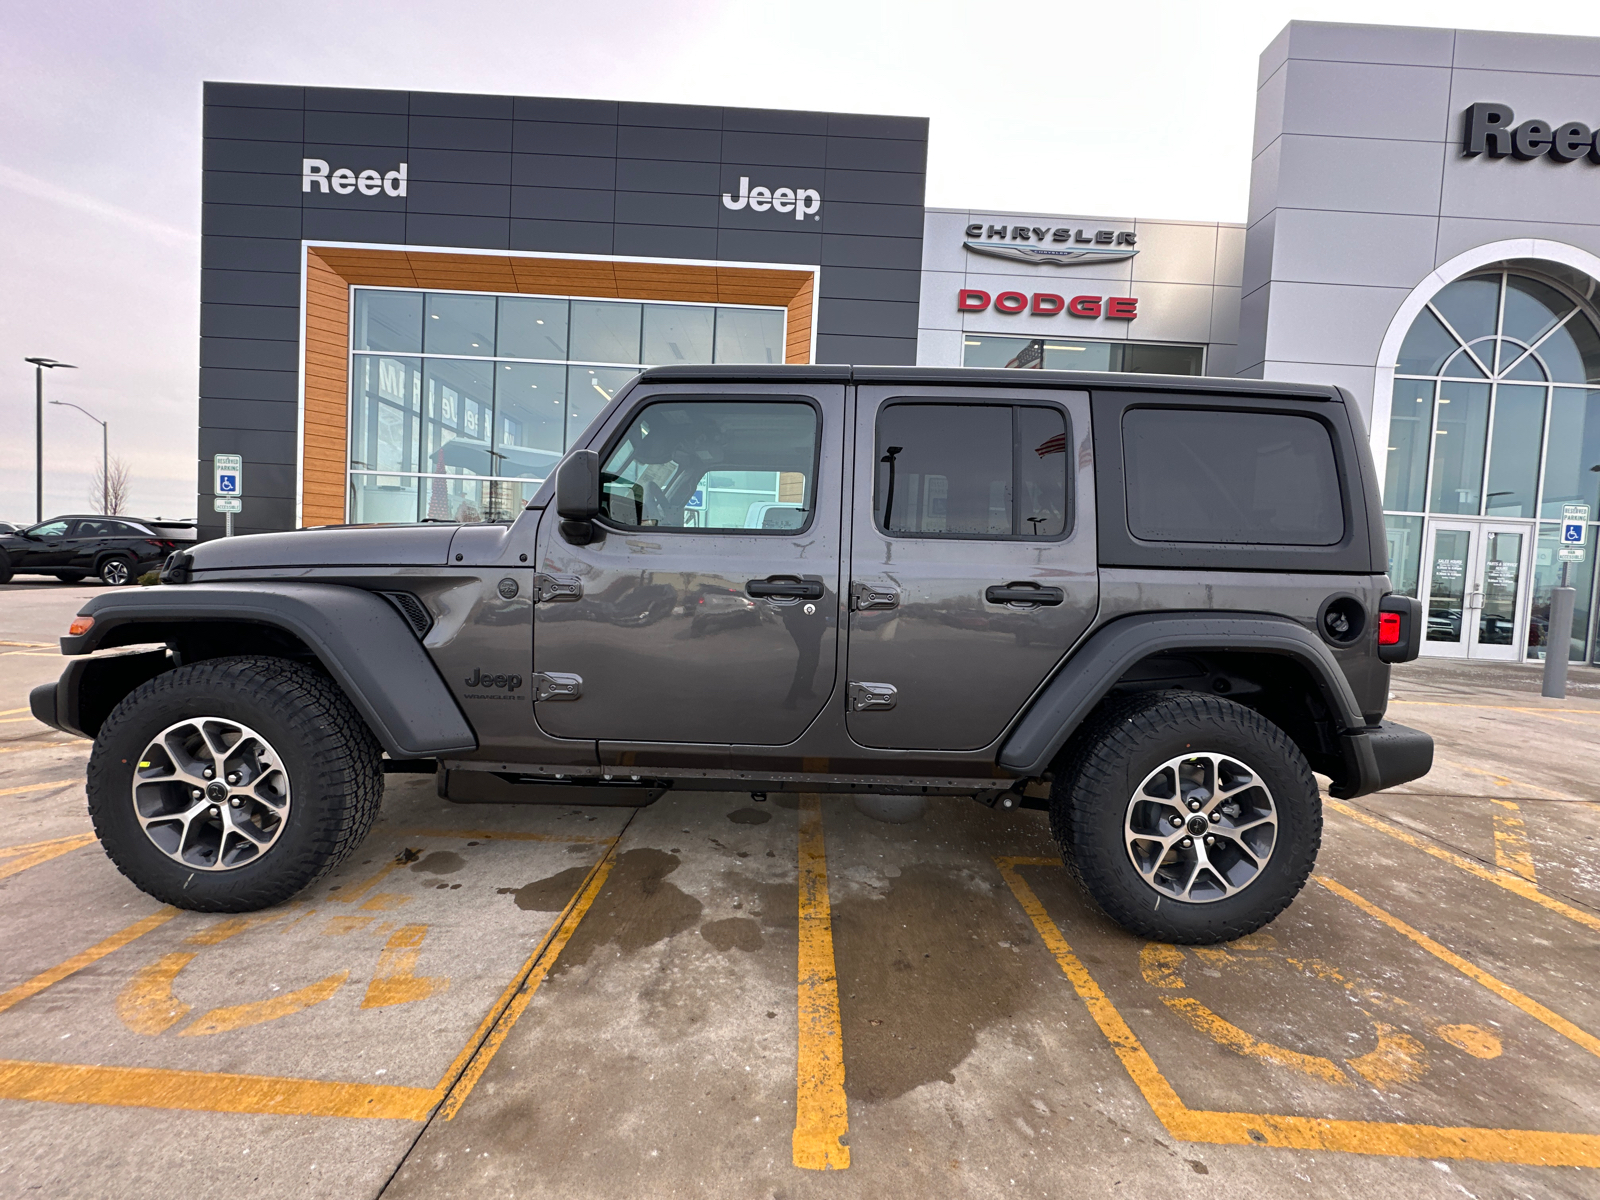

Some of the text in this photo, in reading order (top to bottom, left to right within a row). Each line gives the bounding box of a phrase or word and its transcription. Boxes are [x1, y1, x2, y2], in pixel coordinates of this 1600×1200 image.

[1462, 102, 1600, 165] Ree
[302, 158, 408, 197] Reed
[722, 176, 821, 221] Jeep
[965, 223, 1137, 245] CHRYSLER
[958, 289, 1138, 321] DODGE
[465, 667, 522, 692] Jeep
